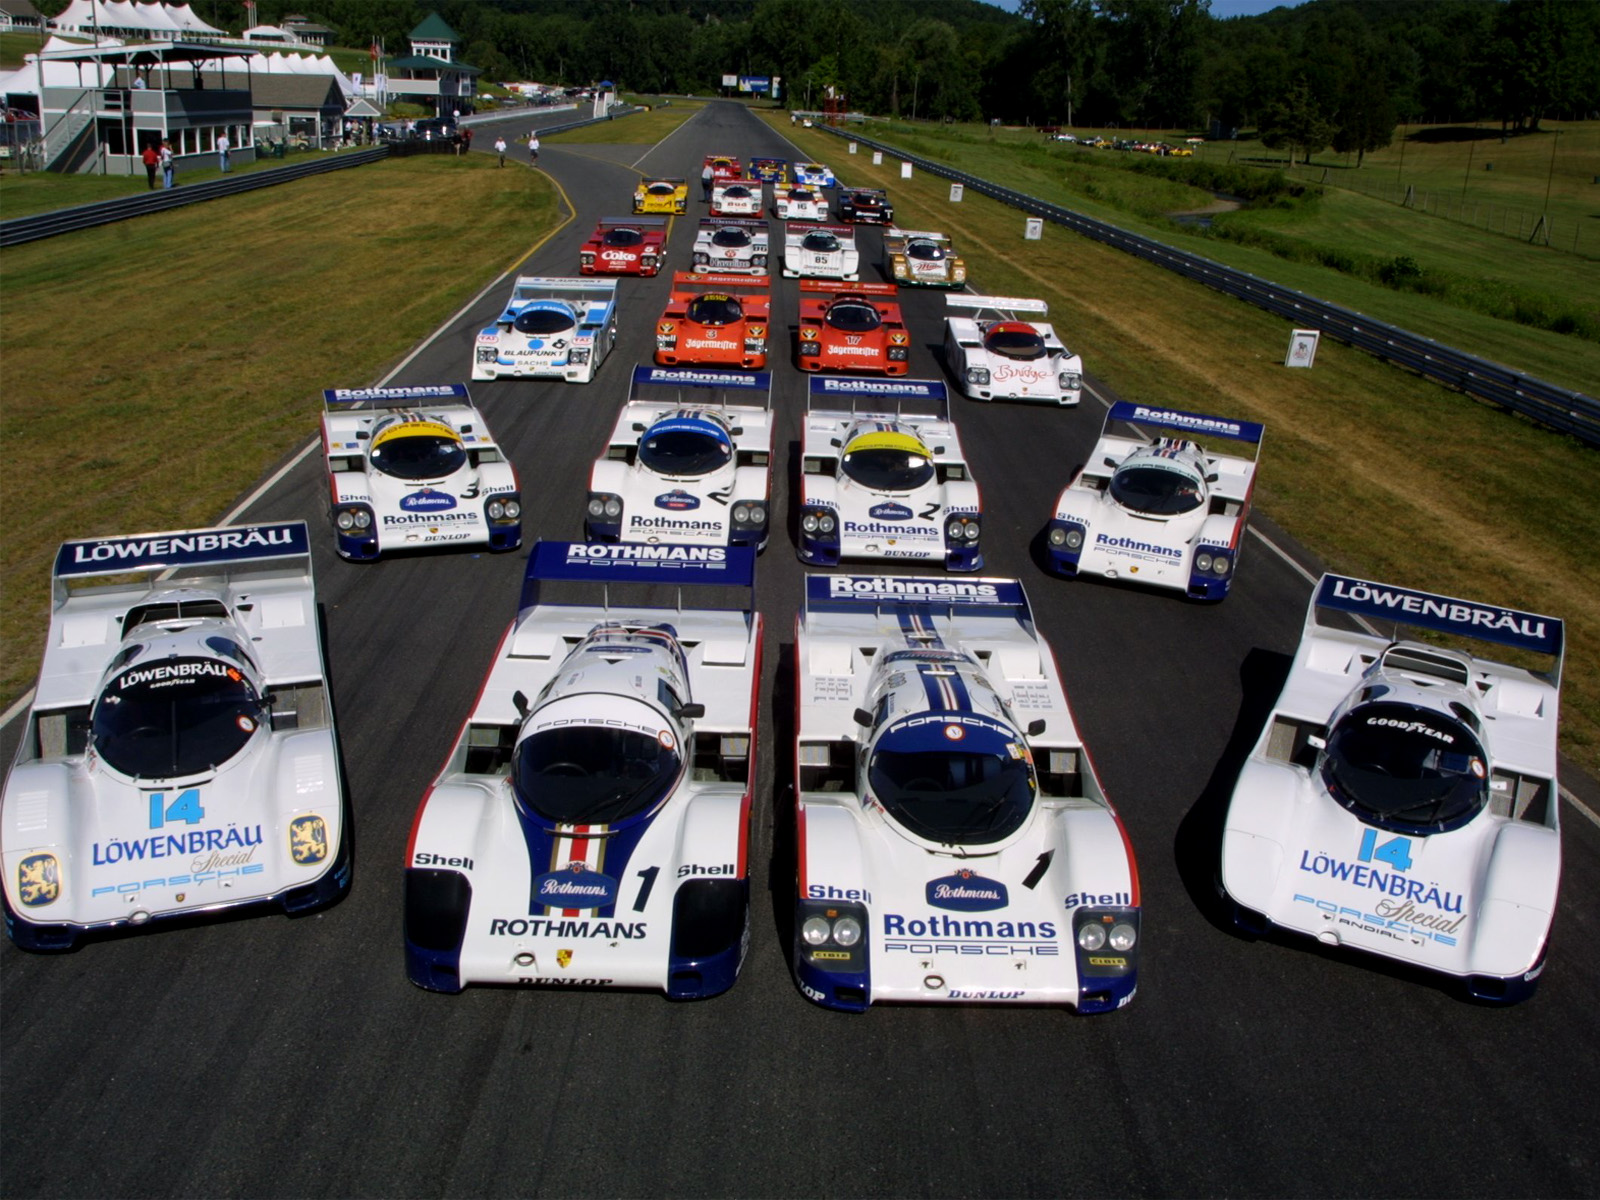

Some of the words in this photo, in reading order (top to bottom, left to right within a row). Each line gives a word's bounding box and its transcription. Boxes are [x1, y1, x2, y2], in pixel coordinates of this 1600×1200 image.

[601, 249, 637, 261] Coke
[815, 256, 827, 264] 85
[552, 339, 568, 349] 6
[657, 334, 676, 342] Shell
[685, 338, 738, 350] Jägermeister
[744, 337, 765, 346] Shell
[845, 336, 862, 345] 17
[827, 344, 880, 357] Jägermeister
[651, 370, 756, 382] Rothmans
[993, 365, 1055, 385] Bridge
[333, 384, 454, 398] Rothmans
[824, 379, 929, 392] Rothmans
[1133, 406, 1241, 431] Rothmans
[652, 425, 720, 436] PORSCHE
[1118, 463, 1200, 482] PORSCHE
[460, 478, 480, 499] 3
[481, 484, 514, 497] Shell
[405, 496, 451, 506] Rothmans
[383, 511, 478, 525] Rothmans
[873, 507, 909, 517] Rothmans
[918, 502, 941, 521] 2
[942, 505, 978, 516] Shell
[631, 515, 722, 530] Rothmans
[1057, 511, 1091, 528] Shell
[844, 521, 938, 536] Rothmans
[74, 528, 293, 563] LÖWENBRÄU
[424, 533, 470, 542] DUNLOP
[1096, 533, 1182, 558] Rothmans
[567, 544, 726, 561] ROTHMANS
[884, 549, 931, 558] DUNLOP
[1093, 546, 1181, 567] PORSCHE
[566, 559, 726, 570] PORSCHE
[829, 576, 997, 596] Rothmans
[1333, 580, 1546, 638] LÖWENBRÄU
[119, 661, 228, 690] LÖWENBRÄU
[537, 718, 657, 735] PORSCHE
[890, 715, 1014, 738] PORSCHE
[1366, 716, 1454, 744] GOODYEAR
[149, 788, 205, 829] 14
[92, 825, 264, 866] LÖWENBRÄU
[1357, 828, 1413, 872] 14
[191, 847, 257, 873] Special
[414, 852, 475, 871] Shell
[677, 863, 735, 878] Shell
[1022, 848, 1056, 890] 1
[92, 863, 264, 897] PORSCHE
[540, 879, 608, 897] Rothmans
[1299, 849, 1463, 914] LÖWENBRÄU
[632, 865, 661, 913] 1
[808, 884, 872, 904] Shell
[934, 884, 1000, 900] Rothmans
[1065, 892, 1130, 910] Shell
[1293, 893, 1457, 946] PORSCHE
[1375, 898, 1468, 934] Special
[489, 919, 647, 940] ROTHMANS
[884, 914, 1057, 938] Rothmans
[1338, 917, 1405, 942] ANDIAL
[884, 943, 1059, 956] PORSCHE
[518, 976, 613, 986] DUNLOP
[947, 990, 1026, 999] DUNLOP
